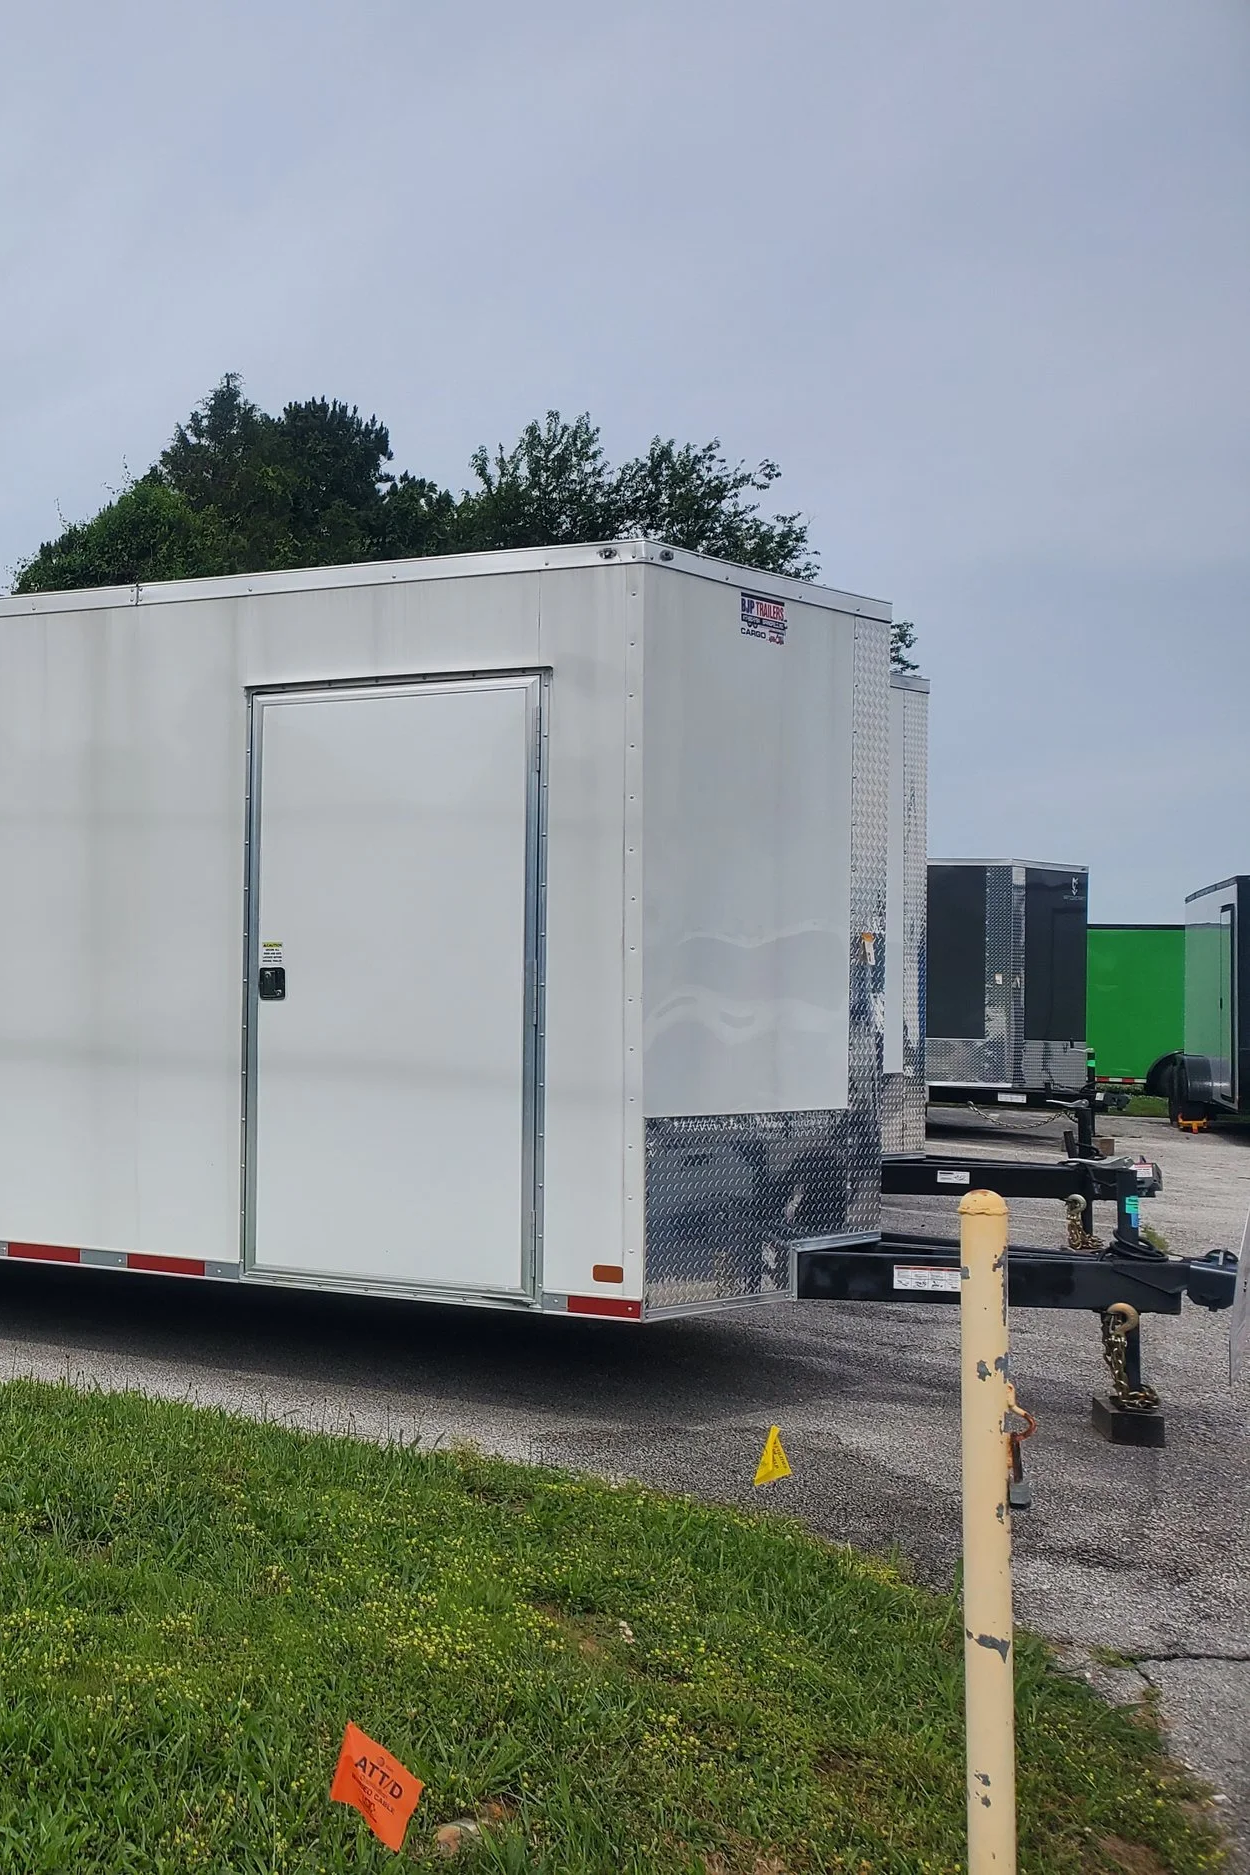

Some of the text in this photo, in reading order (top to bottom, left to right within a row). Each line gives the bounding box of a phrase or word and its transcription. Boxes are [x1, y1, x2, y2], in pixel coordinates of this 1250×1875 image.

[741, 598, 784, 621] BJP TRAILERS
[741, 627, 766, 639] CARGO
[354, 1756, 403, 1799] ATT/D
